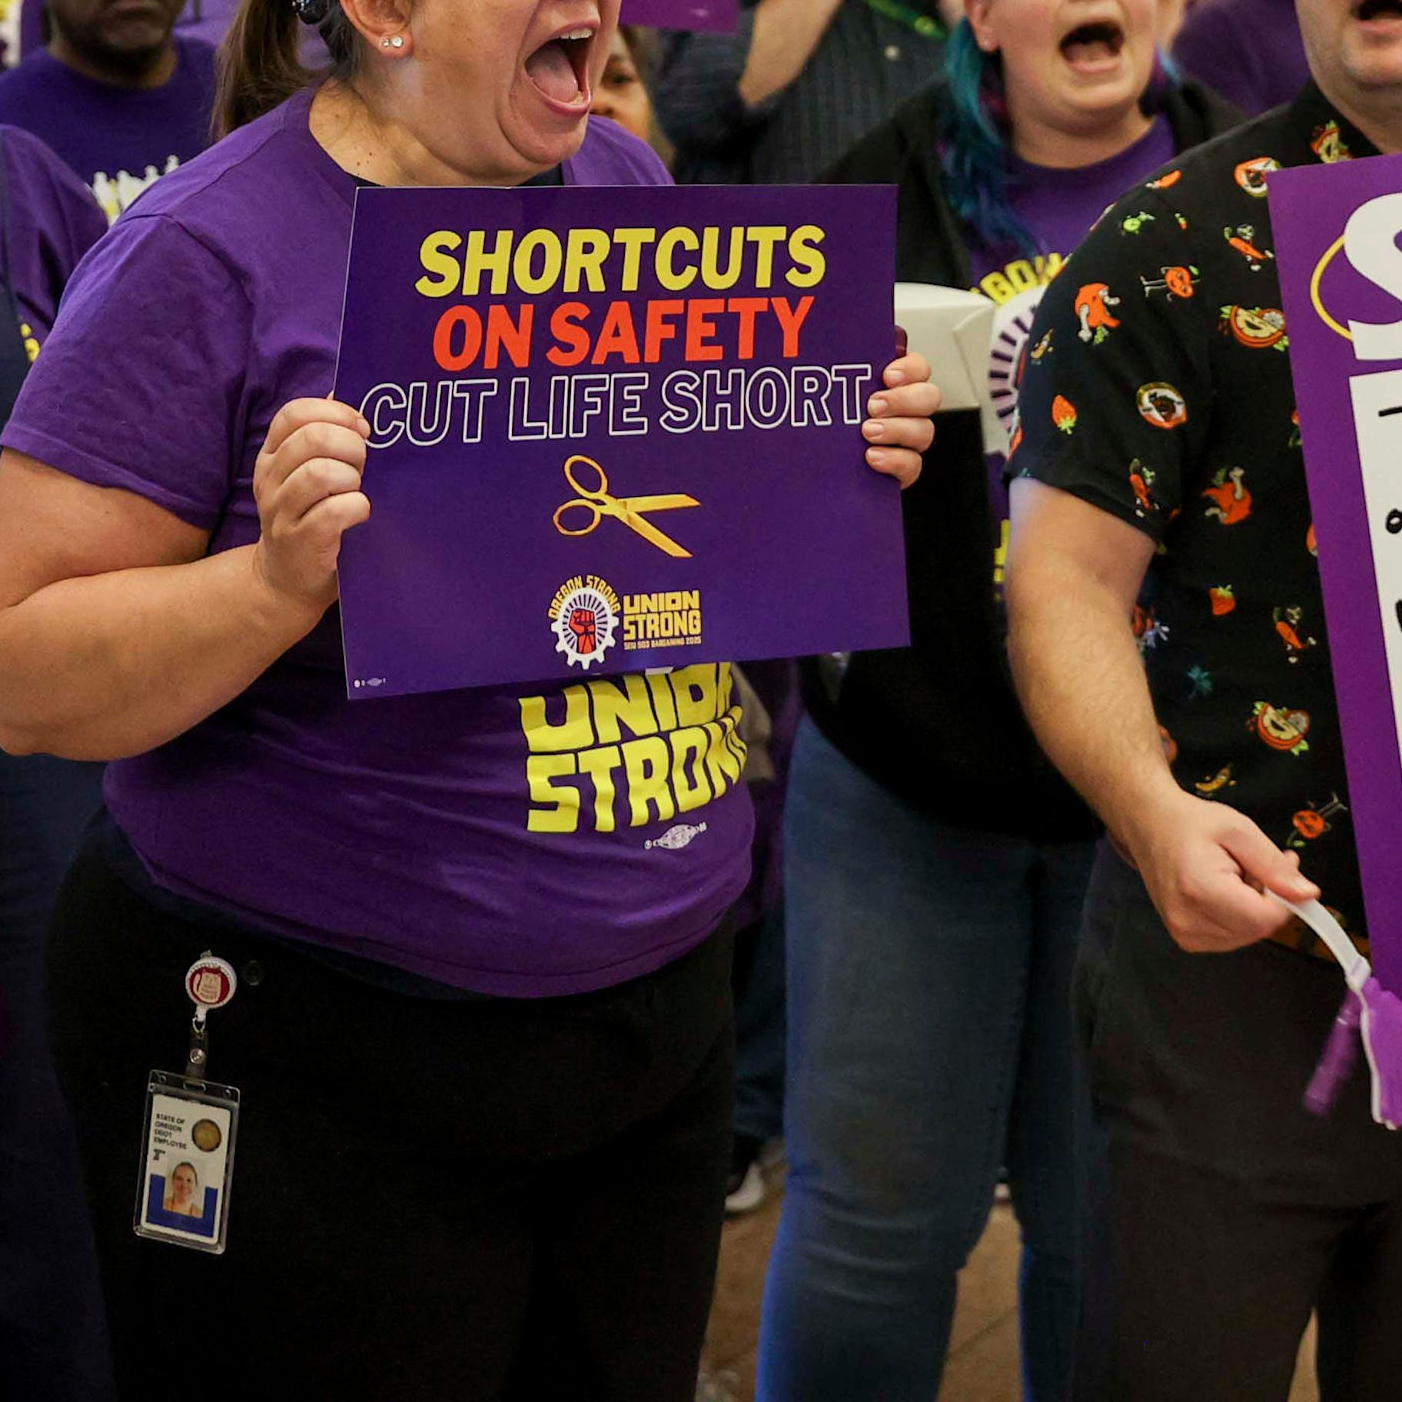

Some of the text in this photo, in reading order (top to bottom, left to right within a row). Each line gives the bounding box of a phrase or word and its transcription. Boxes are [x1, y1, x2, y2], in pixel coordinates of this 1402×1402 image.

[414, 224, 827, 298] SHORTCUTS
[432, 295, 815, 372] ON SAFETY
[362, 363, 873, 449] CUT LIFE SHORT
[548, 574, 622, 620] OREGON STRONG
[623, 590, 701, 615] UNION
[623, 610, 702, 641] STRONG
[526, 705, 748, 833] STRON
